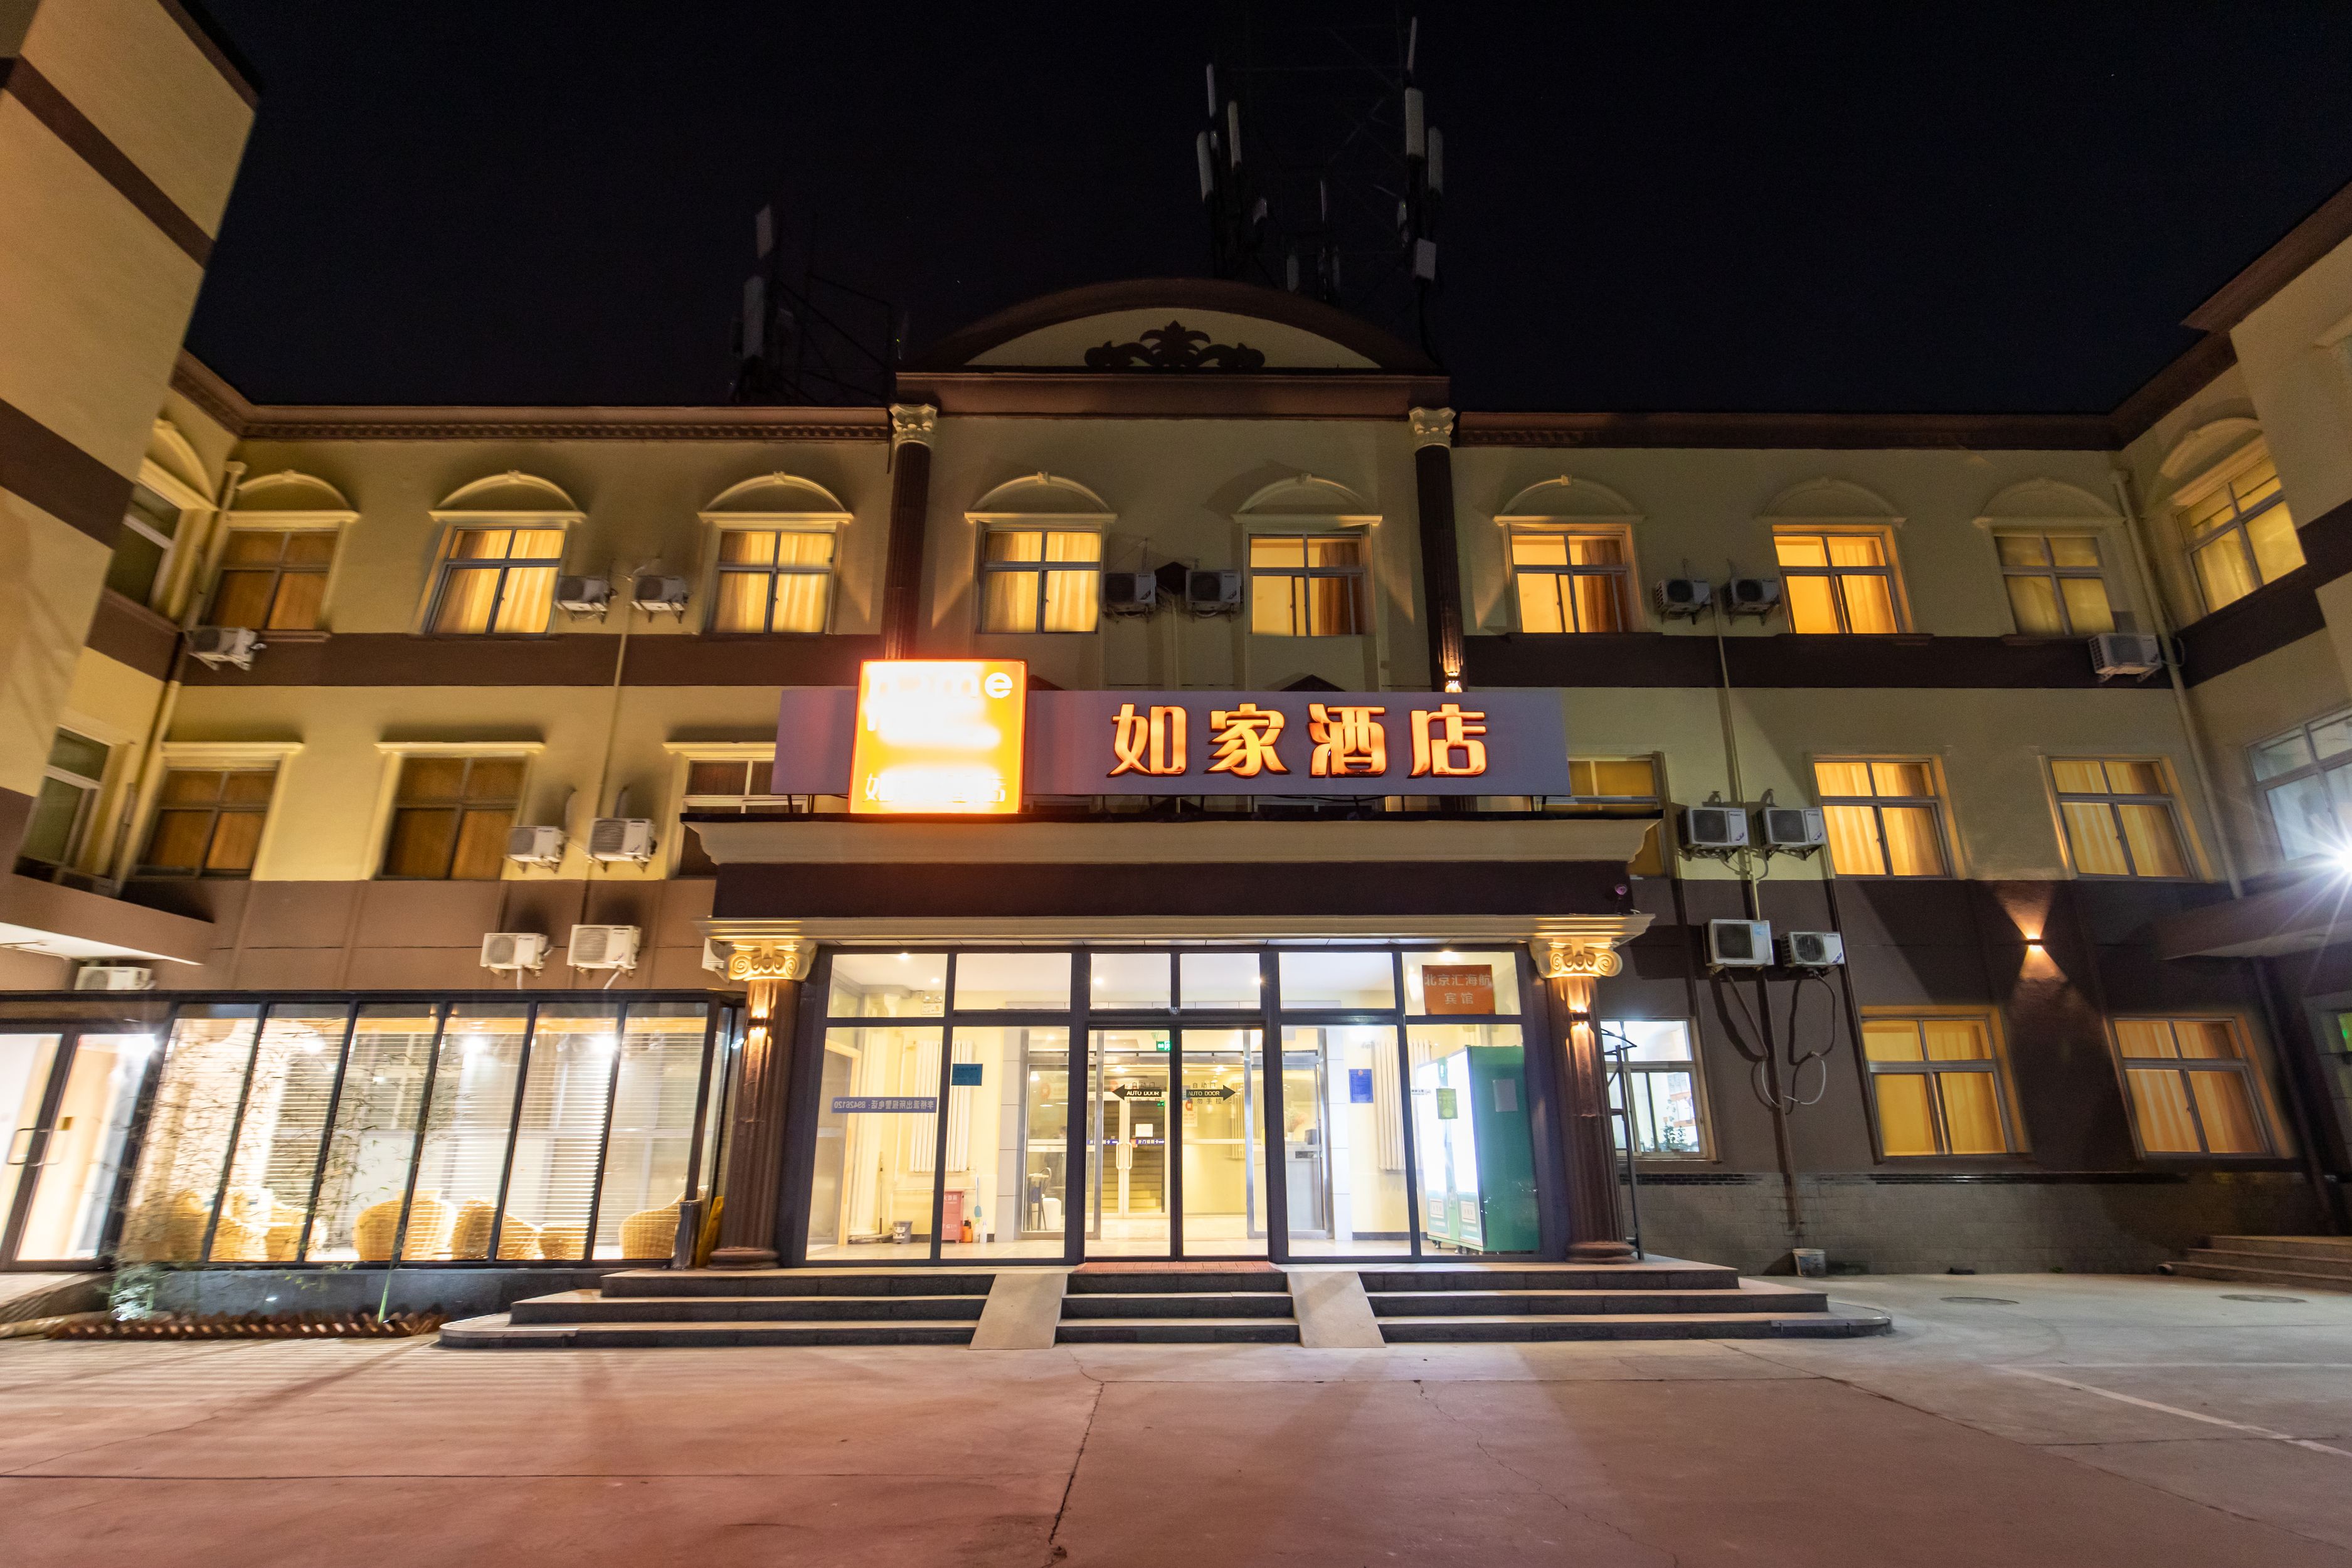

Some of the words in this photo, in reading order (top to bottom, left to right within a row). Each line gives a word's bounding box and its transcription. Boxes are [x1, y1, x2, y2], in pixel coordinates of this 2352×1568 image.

[1106, 703, 1487, 778] 如家酒店
[1444, 992, 1474, 1004] 宾馆
